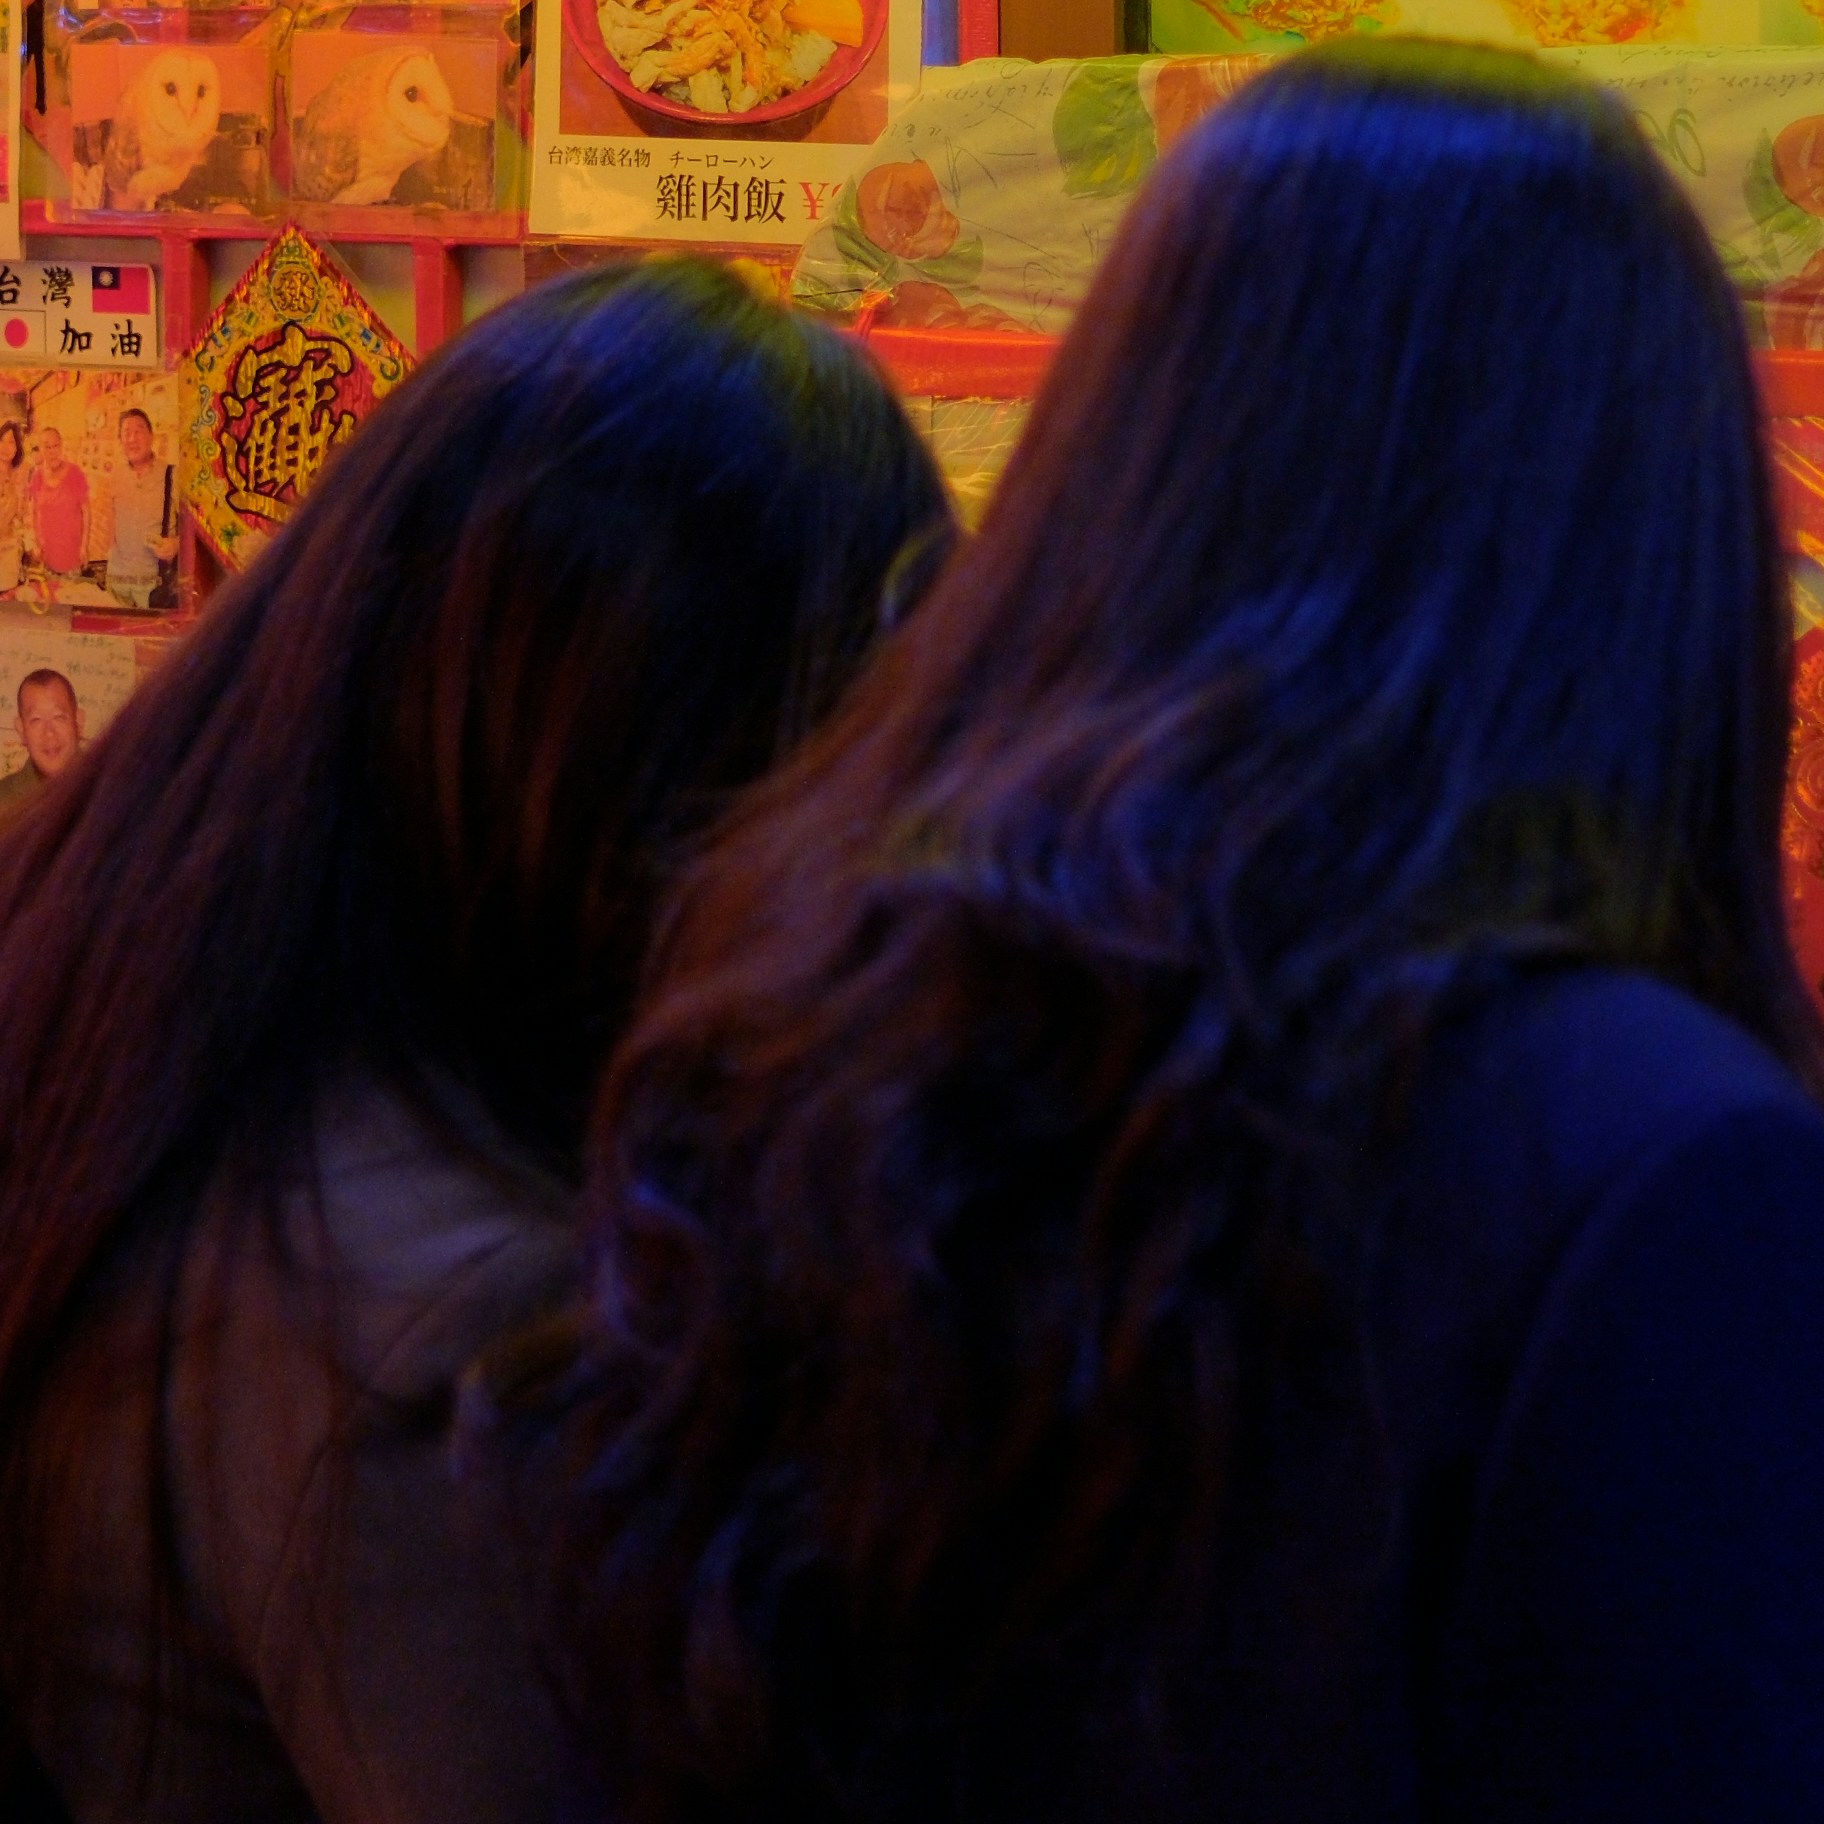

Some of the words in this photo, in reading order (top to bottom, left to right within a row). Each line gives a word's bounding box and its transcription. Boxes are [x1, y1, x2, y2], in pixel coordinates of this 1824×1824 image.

[669, 152, 775, 171] チーローハン
[59, 318, 143, 358] 加油
